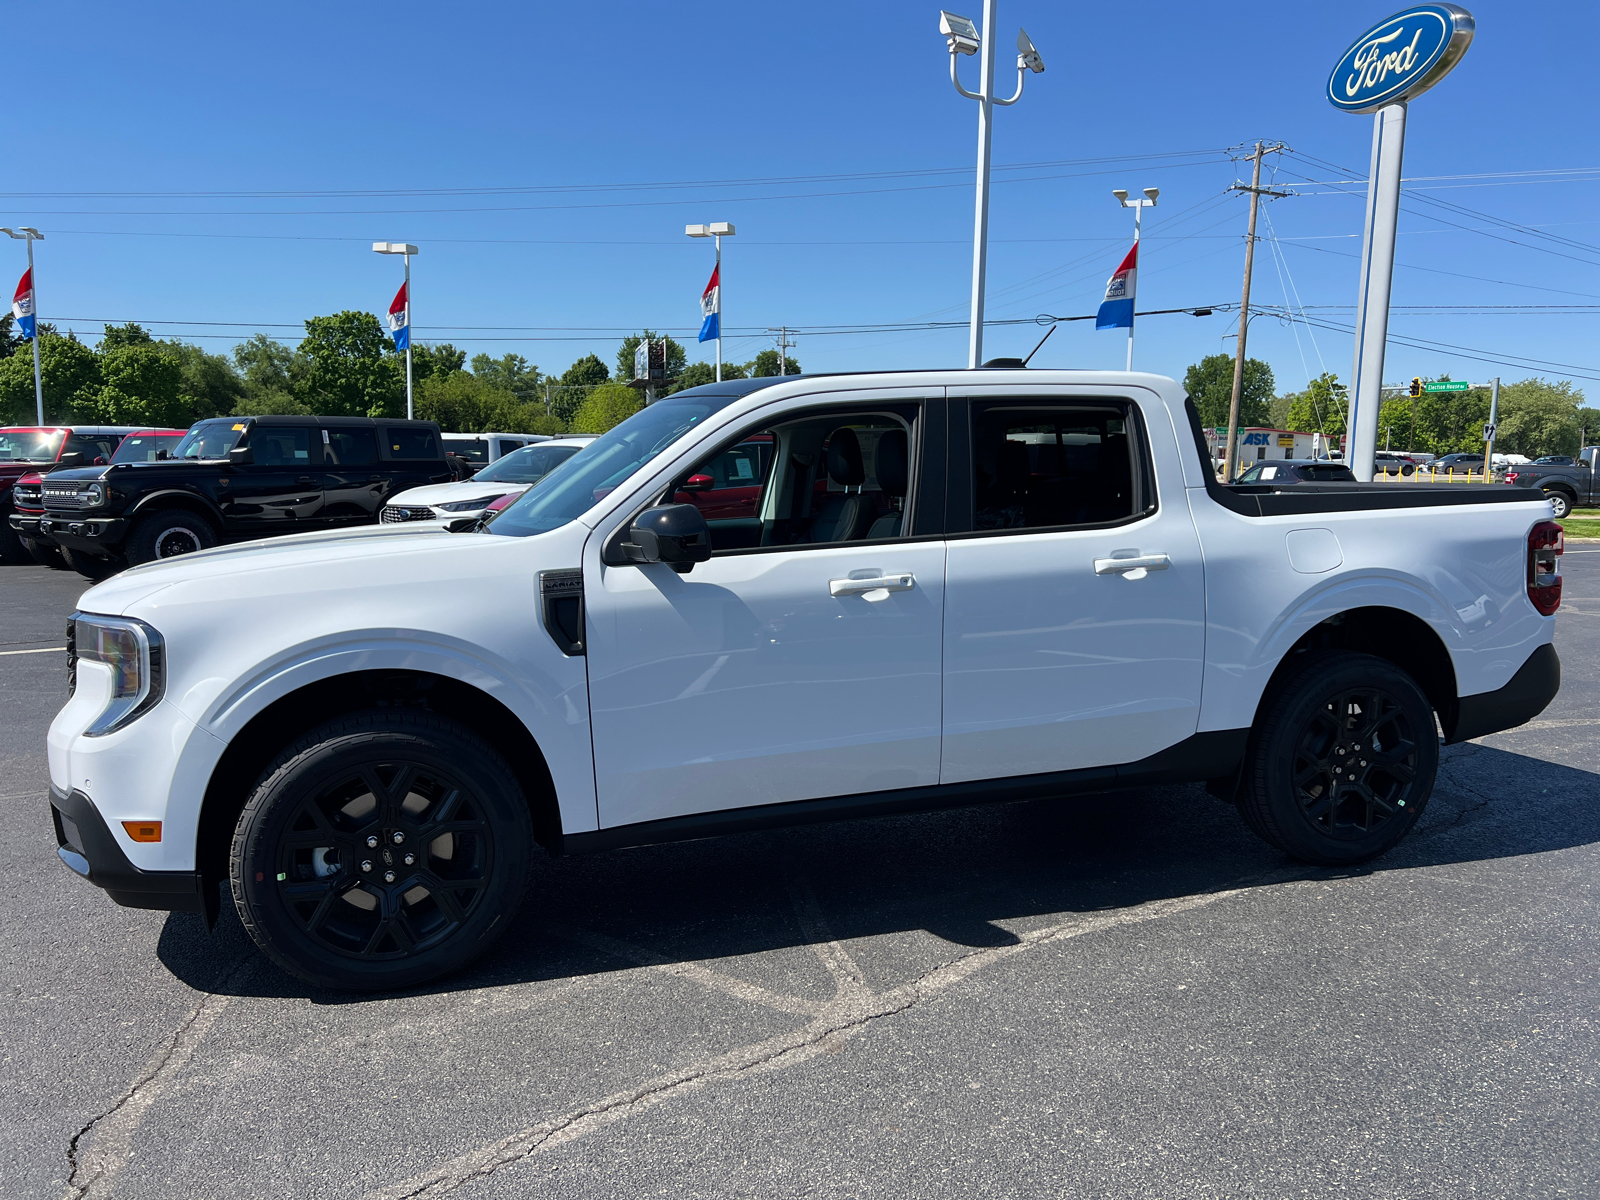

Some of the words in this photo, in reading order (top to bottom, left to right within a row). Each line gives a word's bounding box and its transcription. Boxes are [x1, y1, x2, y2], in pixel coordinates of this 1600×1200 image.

[1346, 26, 1423, 97] Ford
[1242, 433, 1271, 446] ASK
[545, 581, 581, 589] LARIAT
